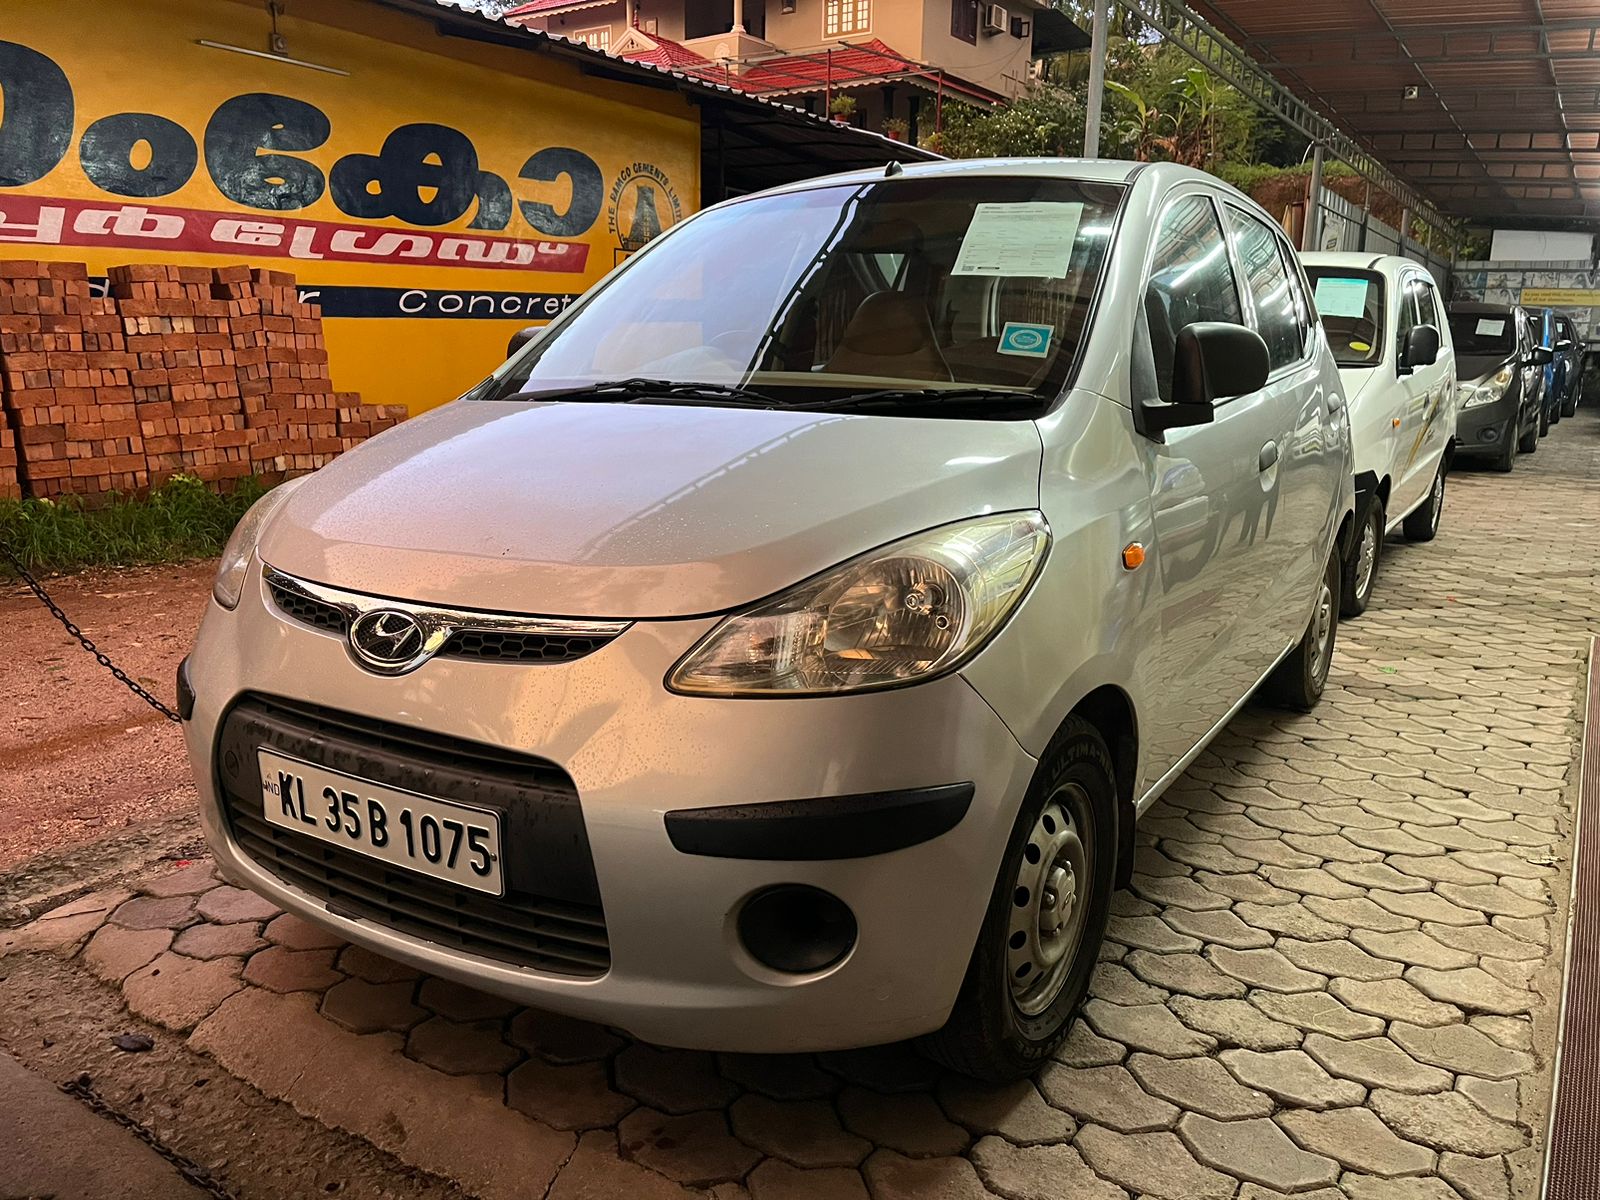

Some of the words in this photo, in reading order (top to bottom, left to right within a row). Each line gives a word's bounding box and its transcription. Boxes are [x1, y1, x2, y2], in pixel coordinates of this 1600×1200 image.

[608, 205, 616, 234] THE
[668, 187, 683, 223] LIMIT
[398, 289, 572, 315] Concret
[278, 770, 317, 827] KL
[322, 786, 362, 840] 35
[367, 798, 389, 848] B
[399, 808, 491, 877] 1075
